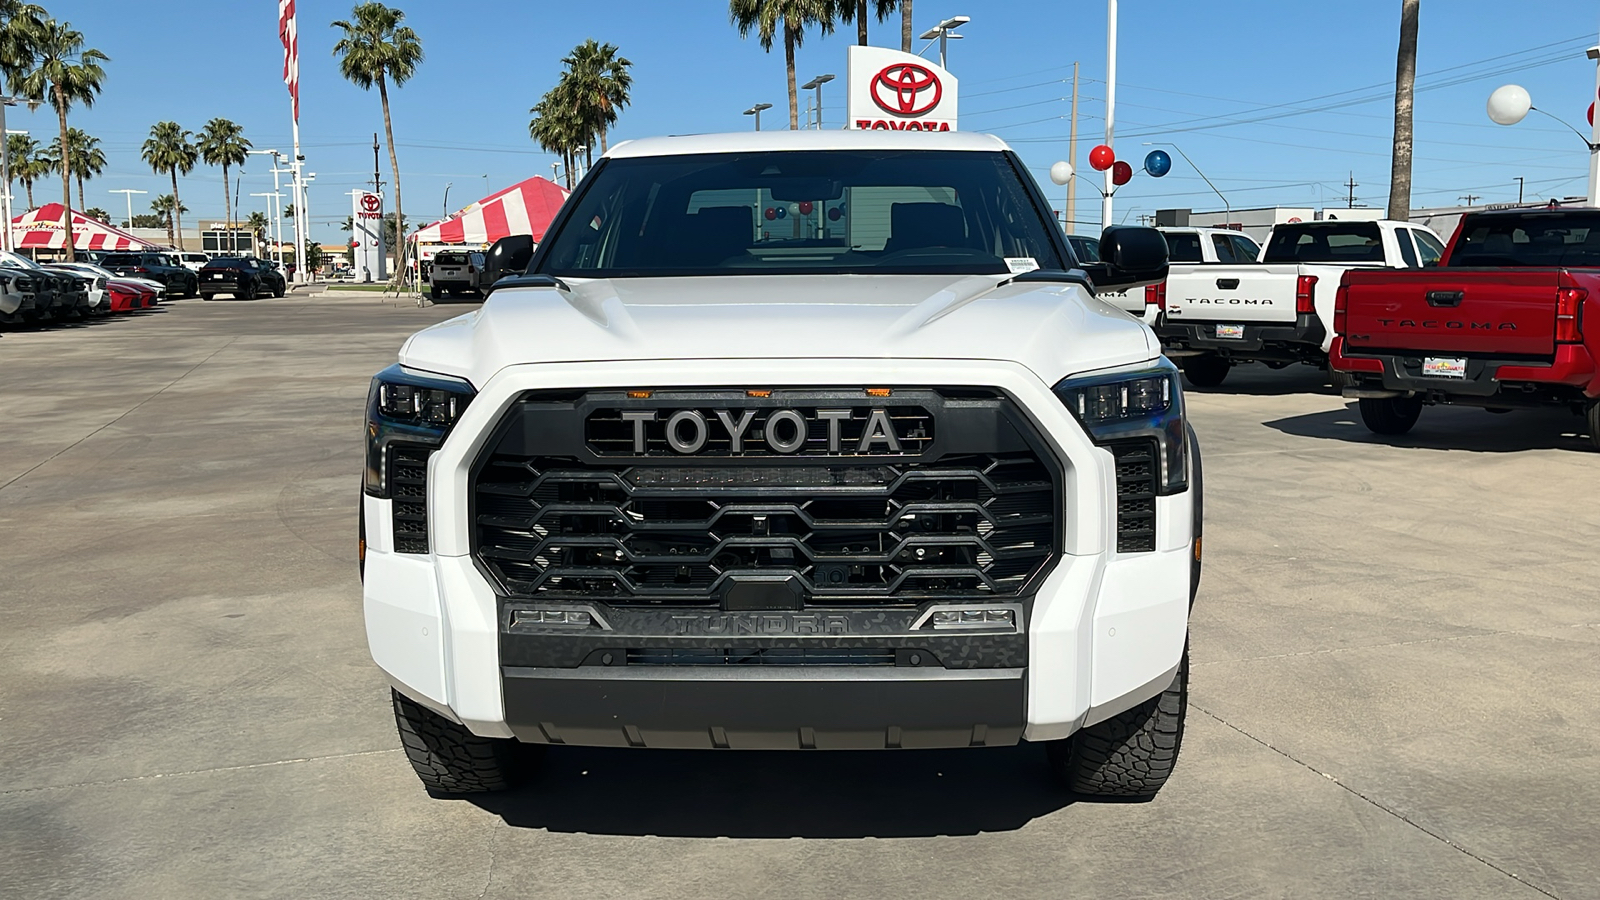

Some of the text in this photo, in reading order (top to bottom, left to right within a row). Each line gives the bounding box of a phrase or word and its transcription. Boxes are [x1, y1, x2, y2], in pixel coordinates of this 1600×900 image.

[1376, 319, 1517, 331] TACOMA
[621, 408, 901, 454] TOYOTA
[672, 615, 849, 633] TUNDRA
